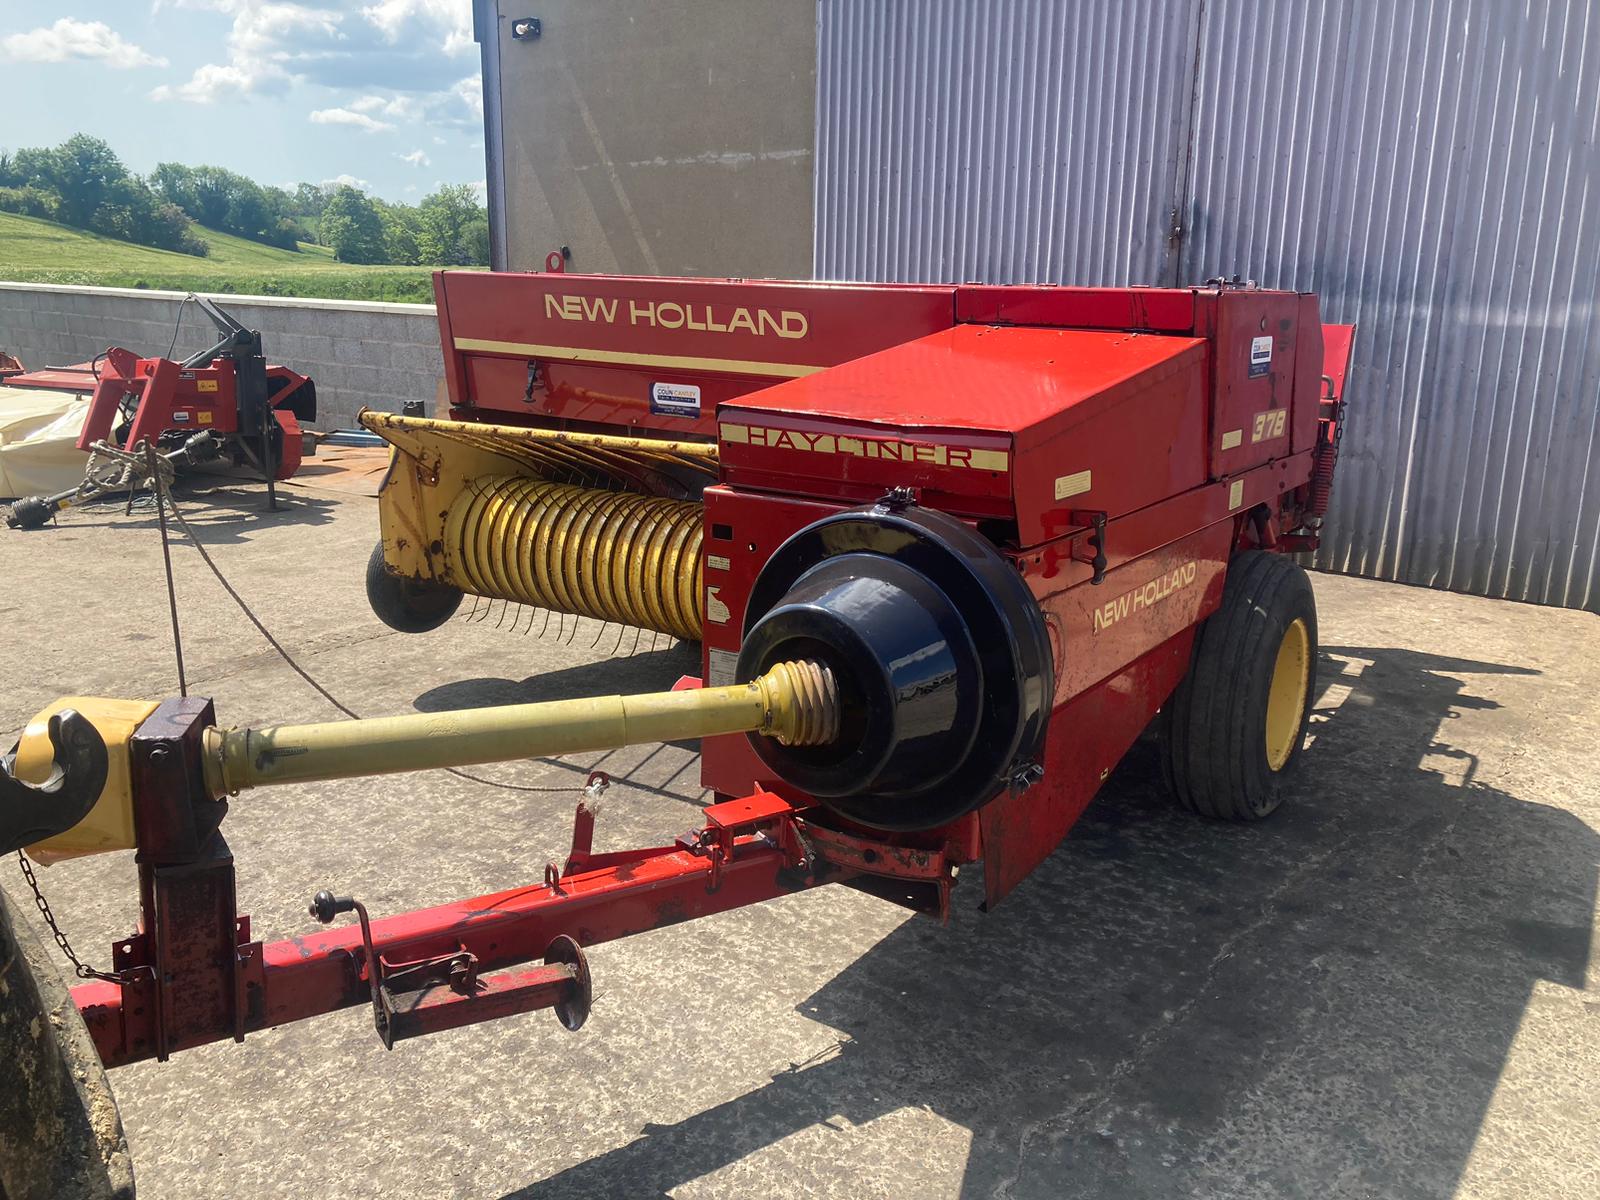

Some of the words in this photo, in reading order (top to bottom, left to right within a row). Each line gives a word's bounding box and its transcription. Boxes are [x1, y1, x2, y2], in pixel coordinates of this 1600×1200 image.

[544, 293, 618, 323] NEW
[630, 300, 808, 339] HOLLAND
[748, 426, 973, 469] HAYLINER
[1252, 410, 1286, 442] 378
[1094, 593, 1131, 635] NEW
[1133, 561, 1196, 612] HOLLAND
